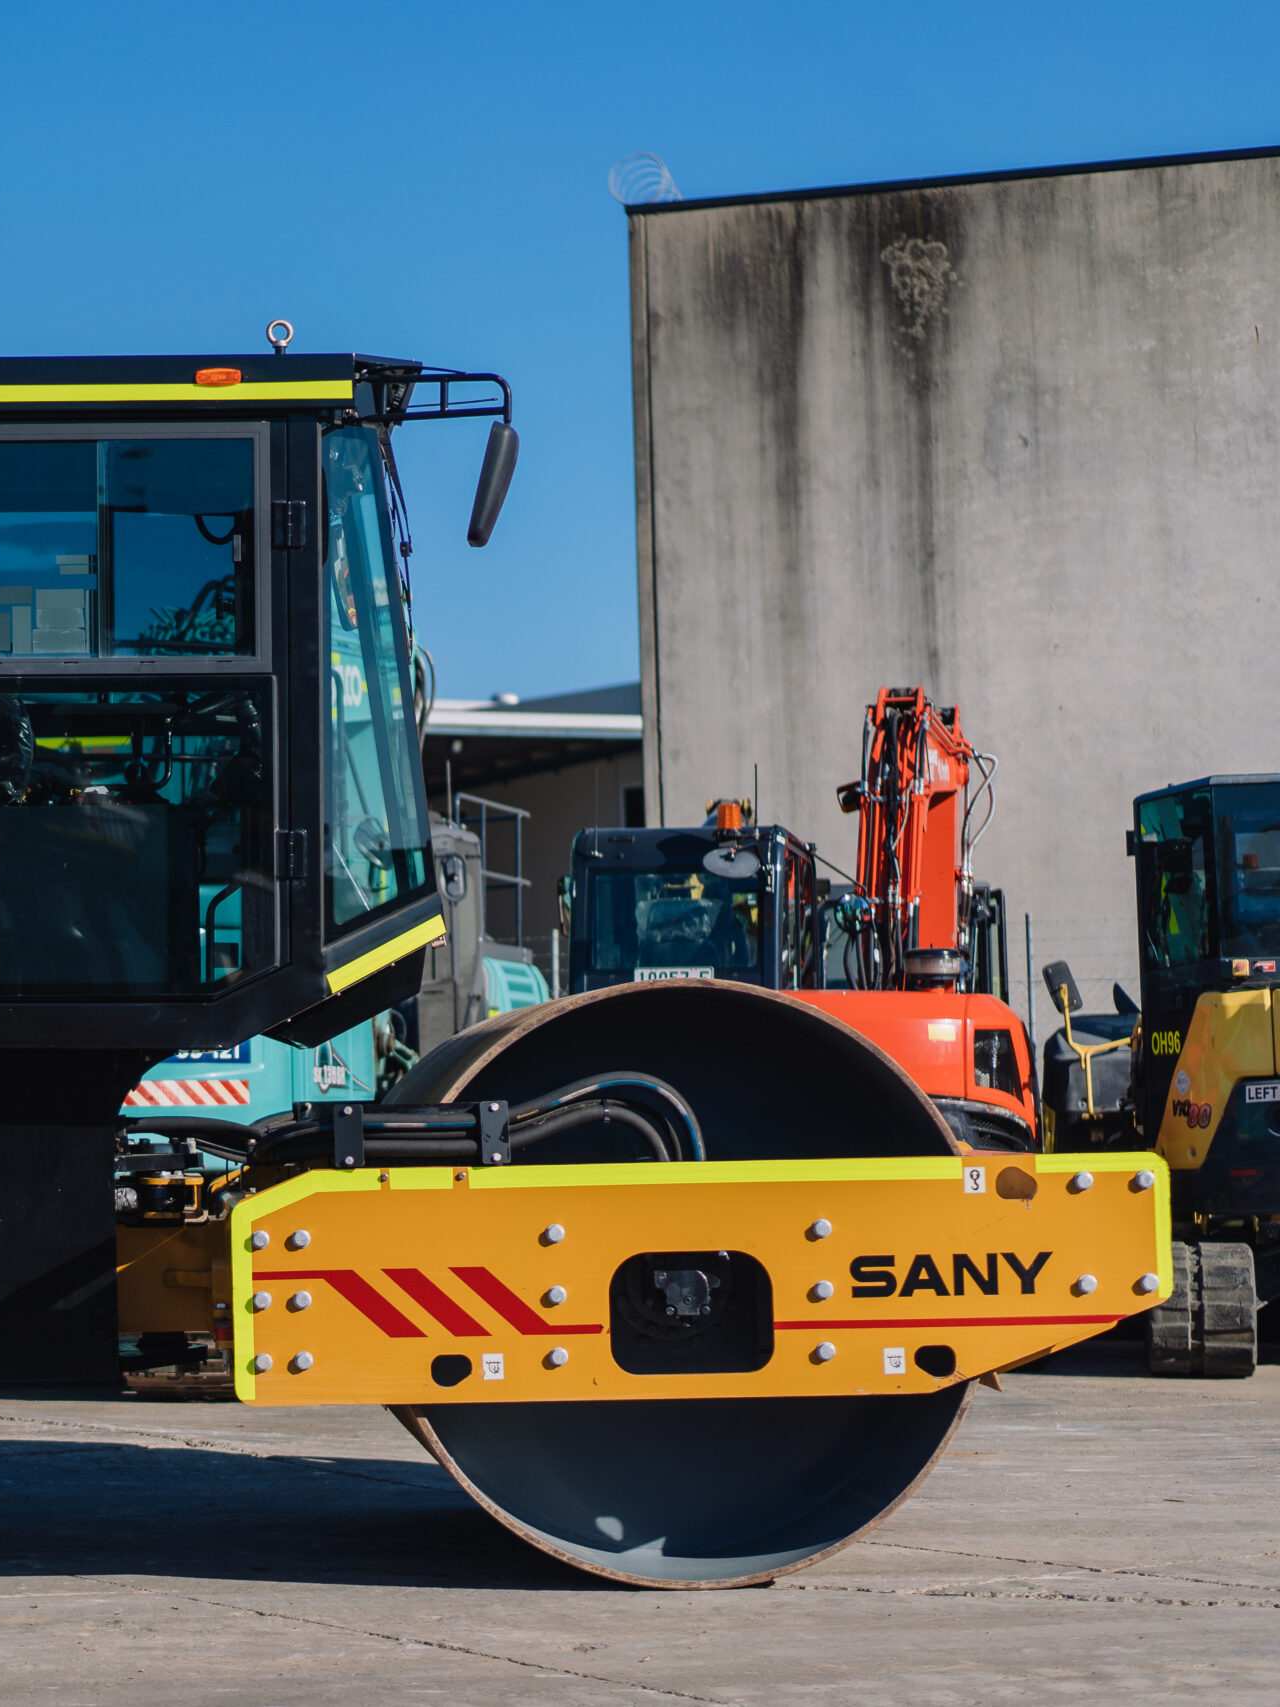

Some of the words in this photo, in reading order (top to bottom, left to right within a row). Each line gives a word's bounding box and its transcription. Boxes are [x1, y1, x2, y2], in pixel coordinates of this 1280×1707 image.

[1151, 1030, 1181, 1055] OH96
[1248, 1087, 1278, 1100] LEFT
[850, 1251, 1054, 1298] SANY
